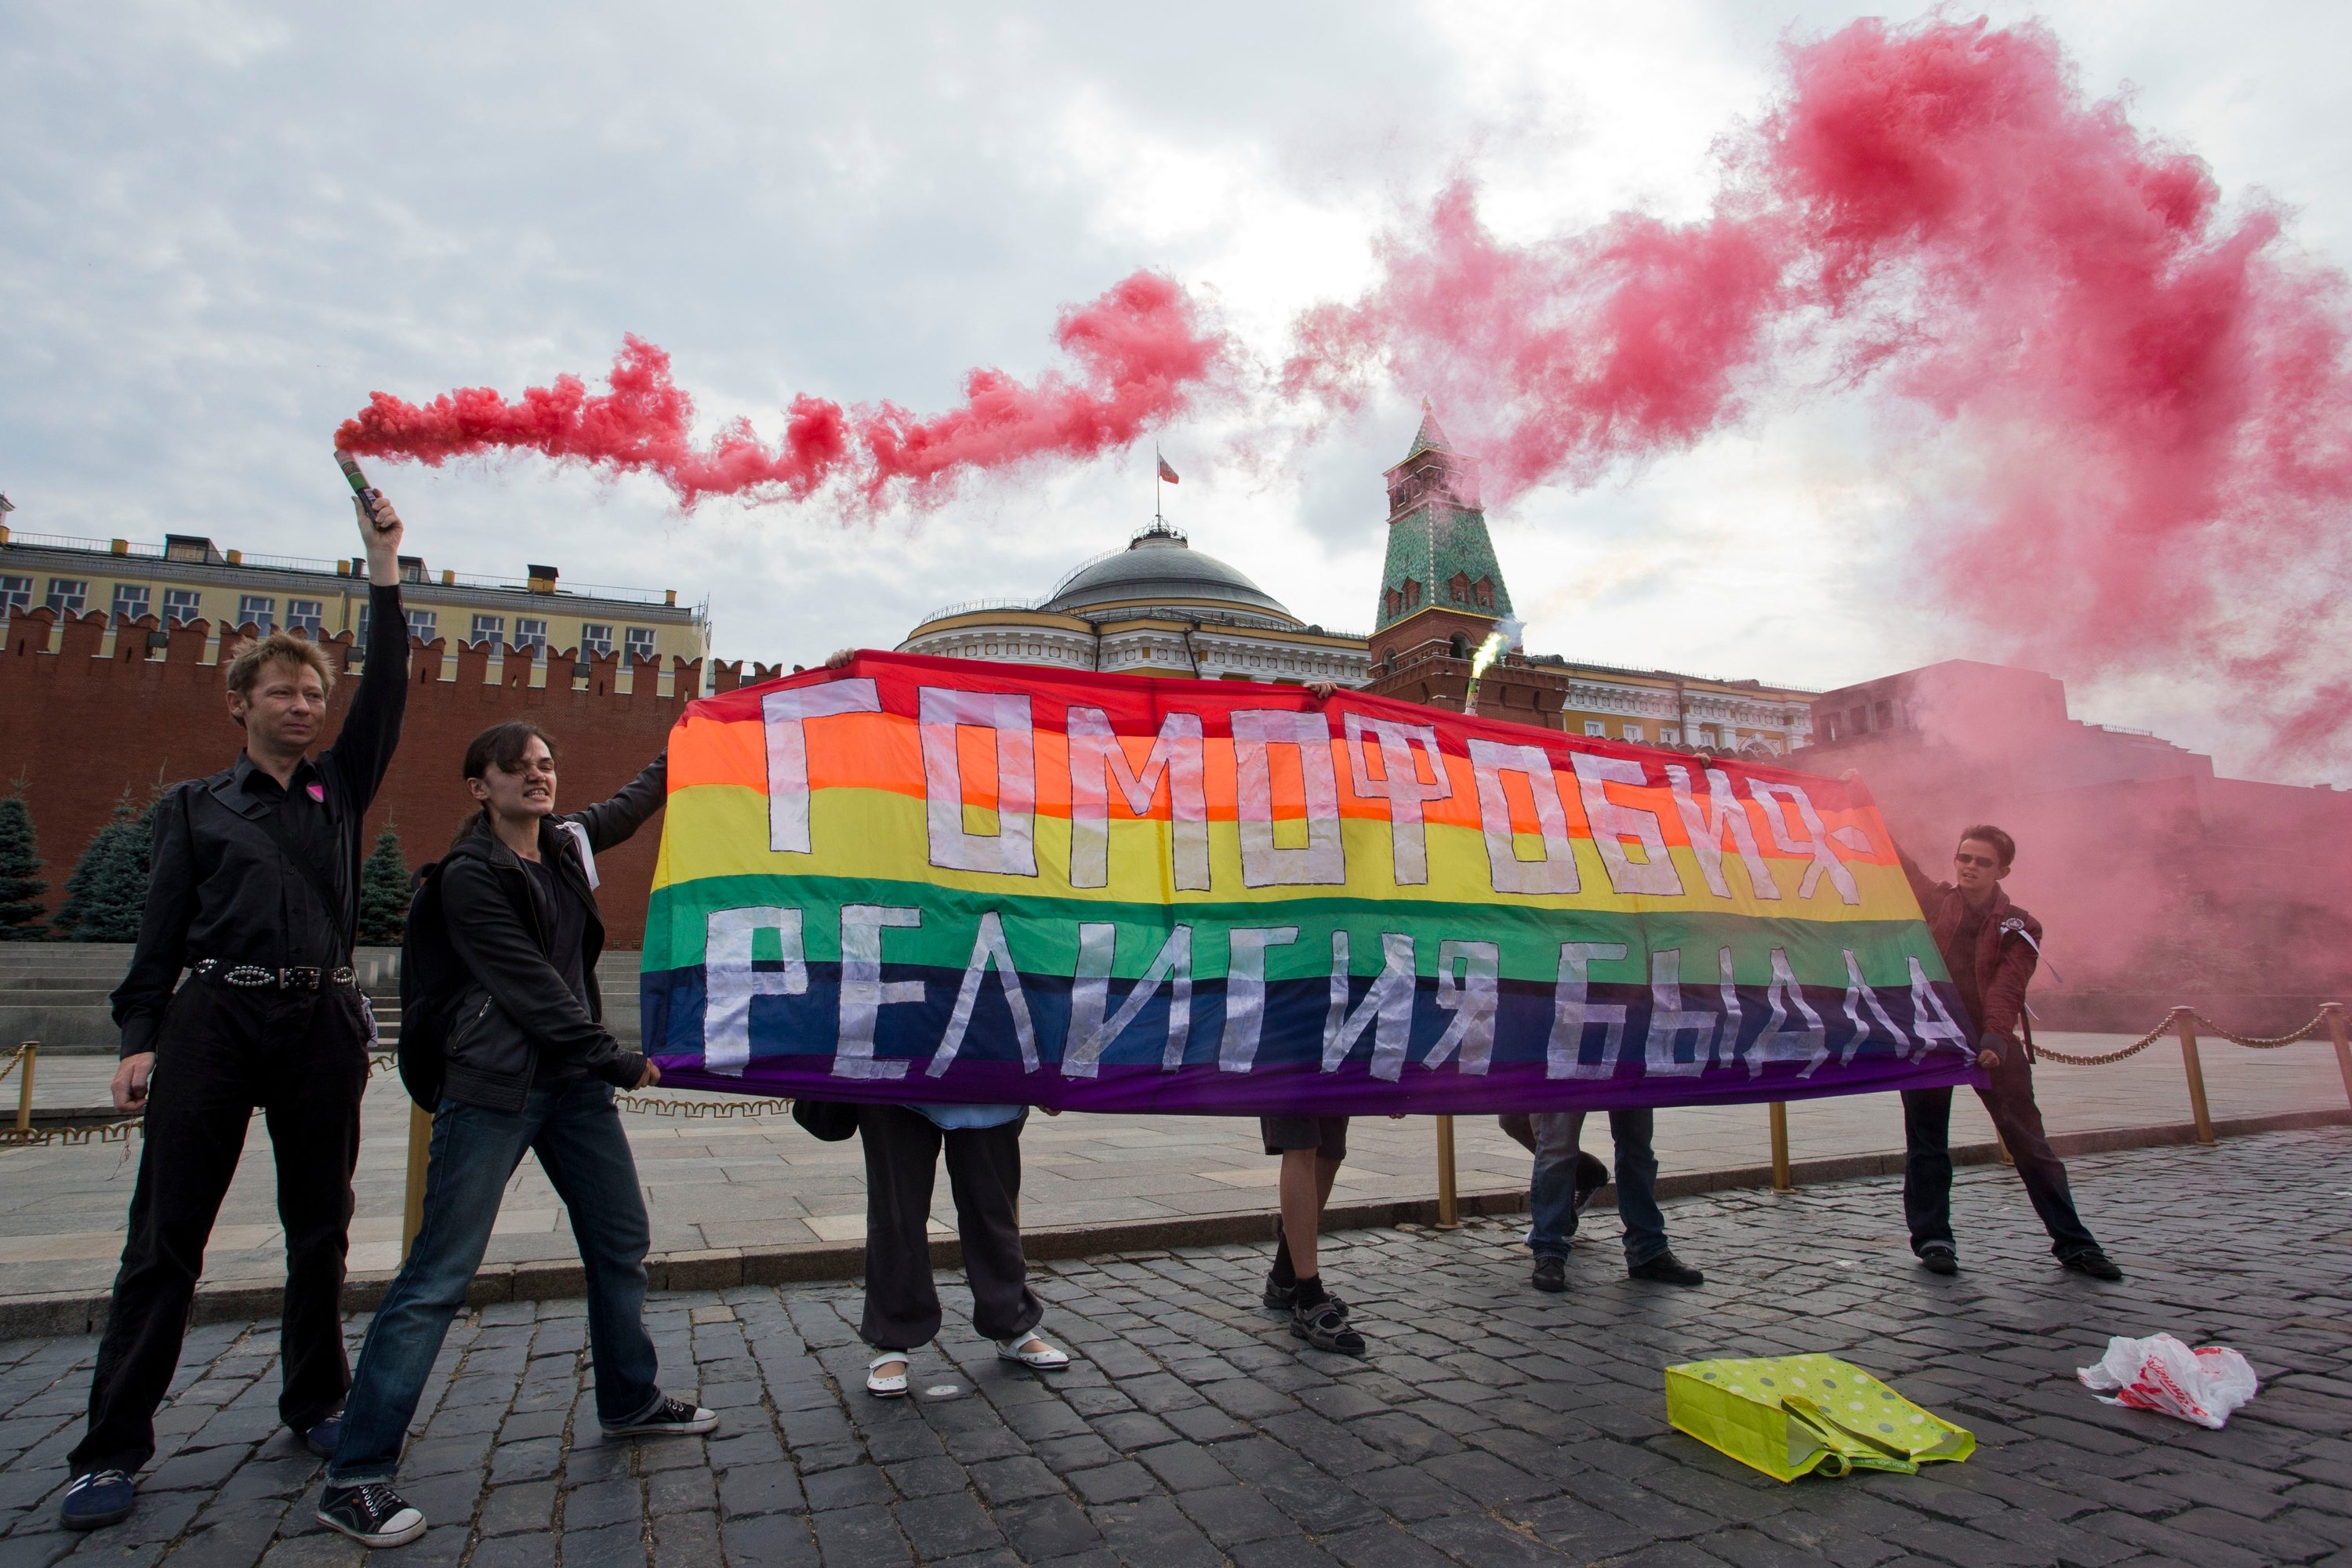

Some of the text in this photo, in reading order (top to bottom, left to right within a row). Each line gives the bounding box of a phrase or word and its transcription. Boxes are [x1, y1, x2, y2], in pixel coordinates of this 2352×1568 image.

[761, 677, 1860, 906] ГОМОФОБИЯ
[704, 903, 1976, 1083] РЕЛИГИЯ БЫДЛА
